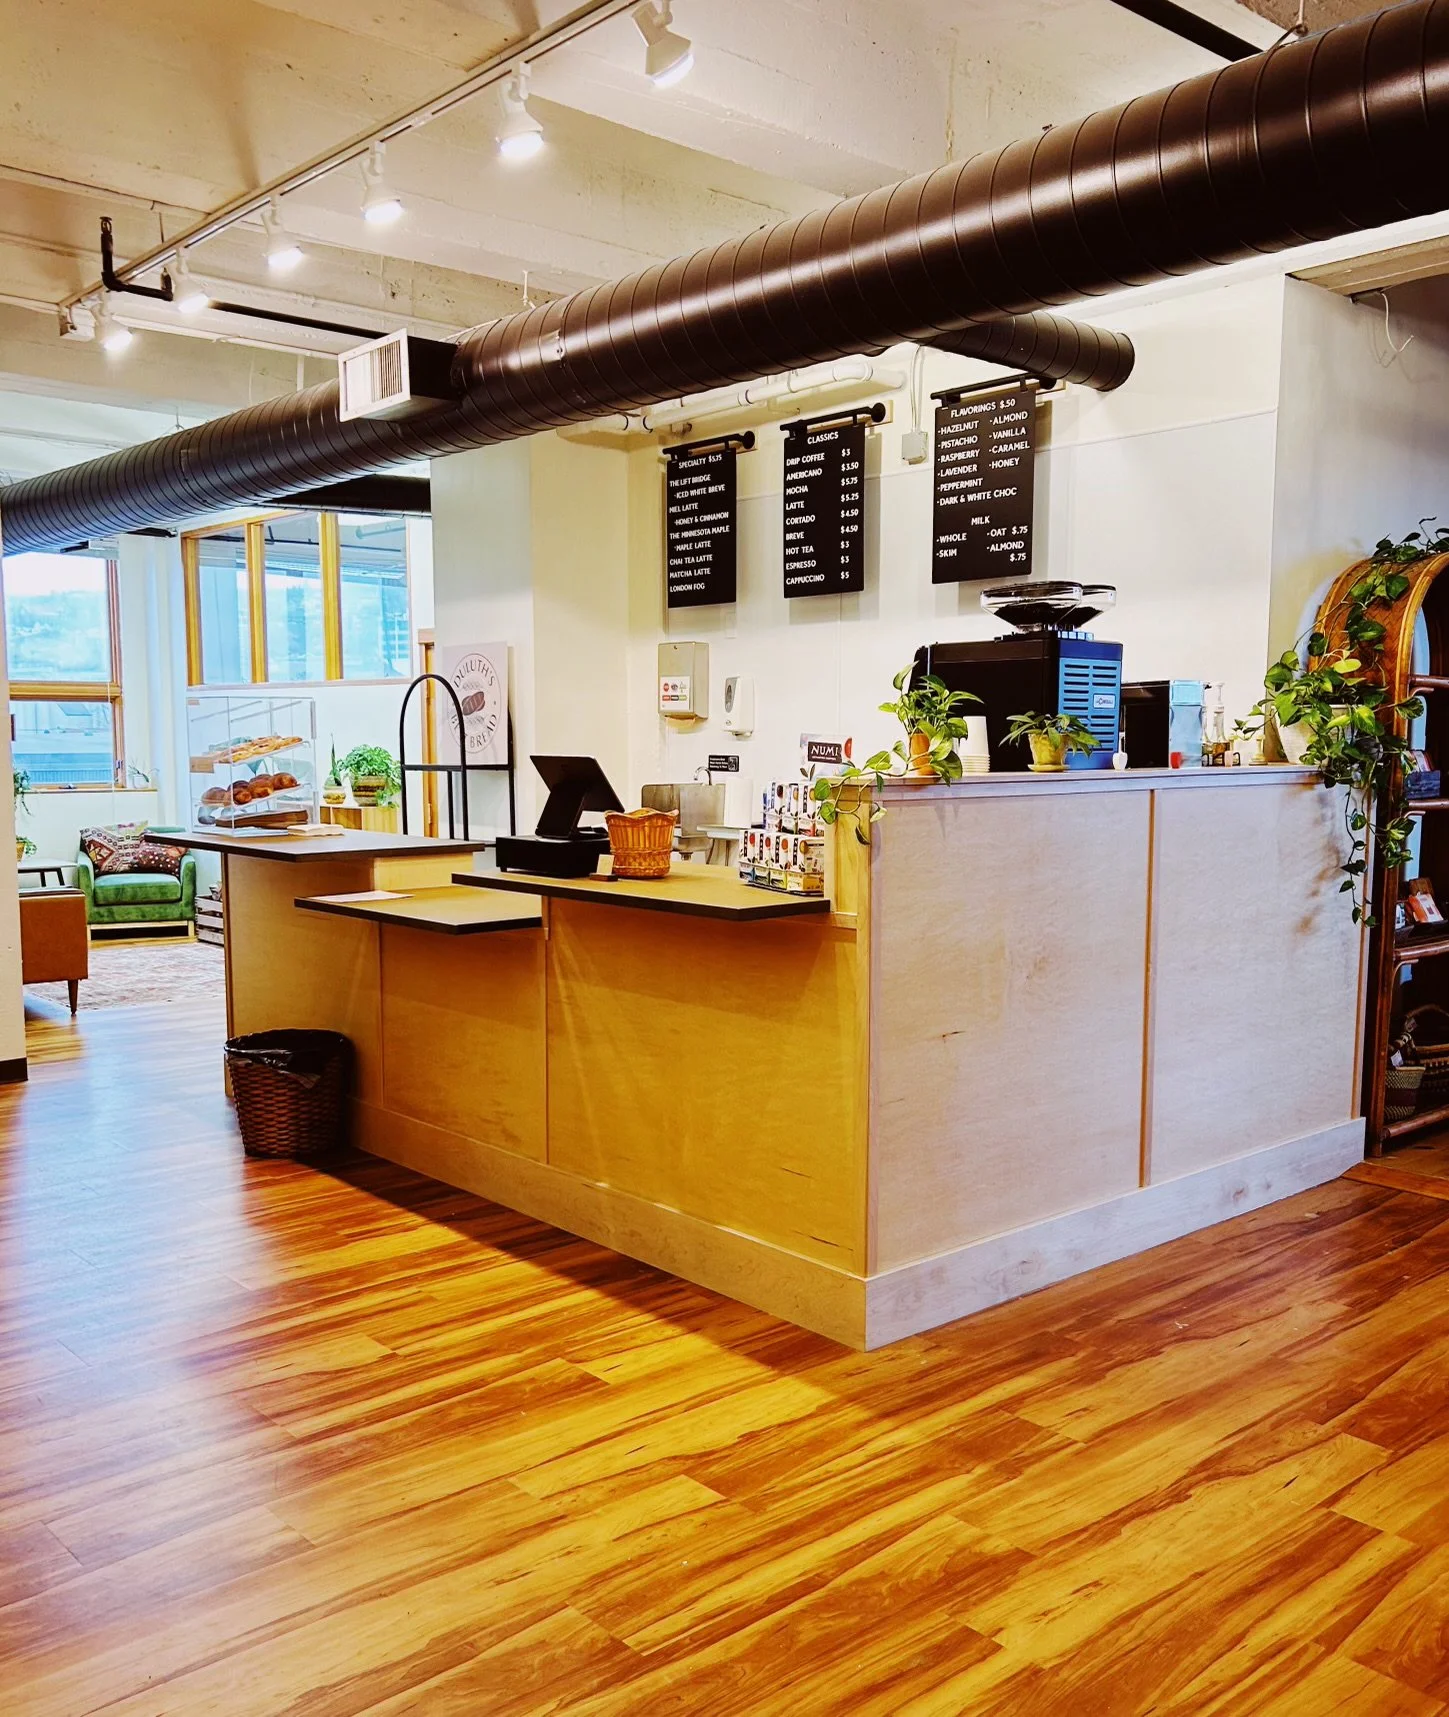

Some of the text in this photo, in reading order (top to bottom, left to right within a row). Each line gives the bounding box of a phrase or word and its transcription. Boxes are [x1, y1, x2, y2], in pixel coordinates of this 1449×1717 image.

[951, 399, 1015, 418] FLAVORINGS $.50
[807, 432, 838, 444] CLASSICS
[679, 457, 706, 469] SPECIALTY
[786, 457, 800, 466] DRIP
[802, 453, 825, 463] COFFEE
[786, 468, 823, 481] AMERICANO
[690, 488, 706, 496] WHITE
[709, 484, 725, 493] BREVE
[786, 485, 808, 495] MOCHA
[960, 495, 965, 503] &
[967, 491, 992, 502] WHITE
[993, 487, 1017, 498] CHOC
[682, 502, 698, 511] LATTE
[786, 501, 804, 510] LATTE
[786, 515, 815, 525] CORTADO
[971, 516, 990, 525] MILK
[681, 528, 711, 538] MINNESOTA
[712, 525, 730, 534] MAPLE
[1012, 525, 1028, 535] $.75
[786, 532, 804, 540] BREVE
[694, 541, 711, 549] LATTE
[786, 547, 799, 555] HOT
[801, 545, 814, 553] TEA
[696, 554, 713, 562] LATTE
[1010, 553, 1026, 562] $.75
[786, 560, 816, 570] ESPRESSO
[670, 568, 711, 579] MATCHA LATTE
[786, 574, 825, 585] CAPPUCCINO
[670, 584, 692, 592] LONDON
[454, 659, 495, 688] DULUTH'S
[811, 745, 838, 756] NUMI
